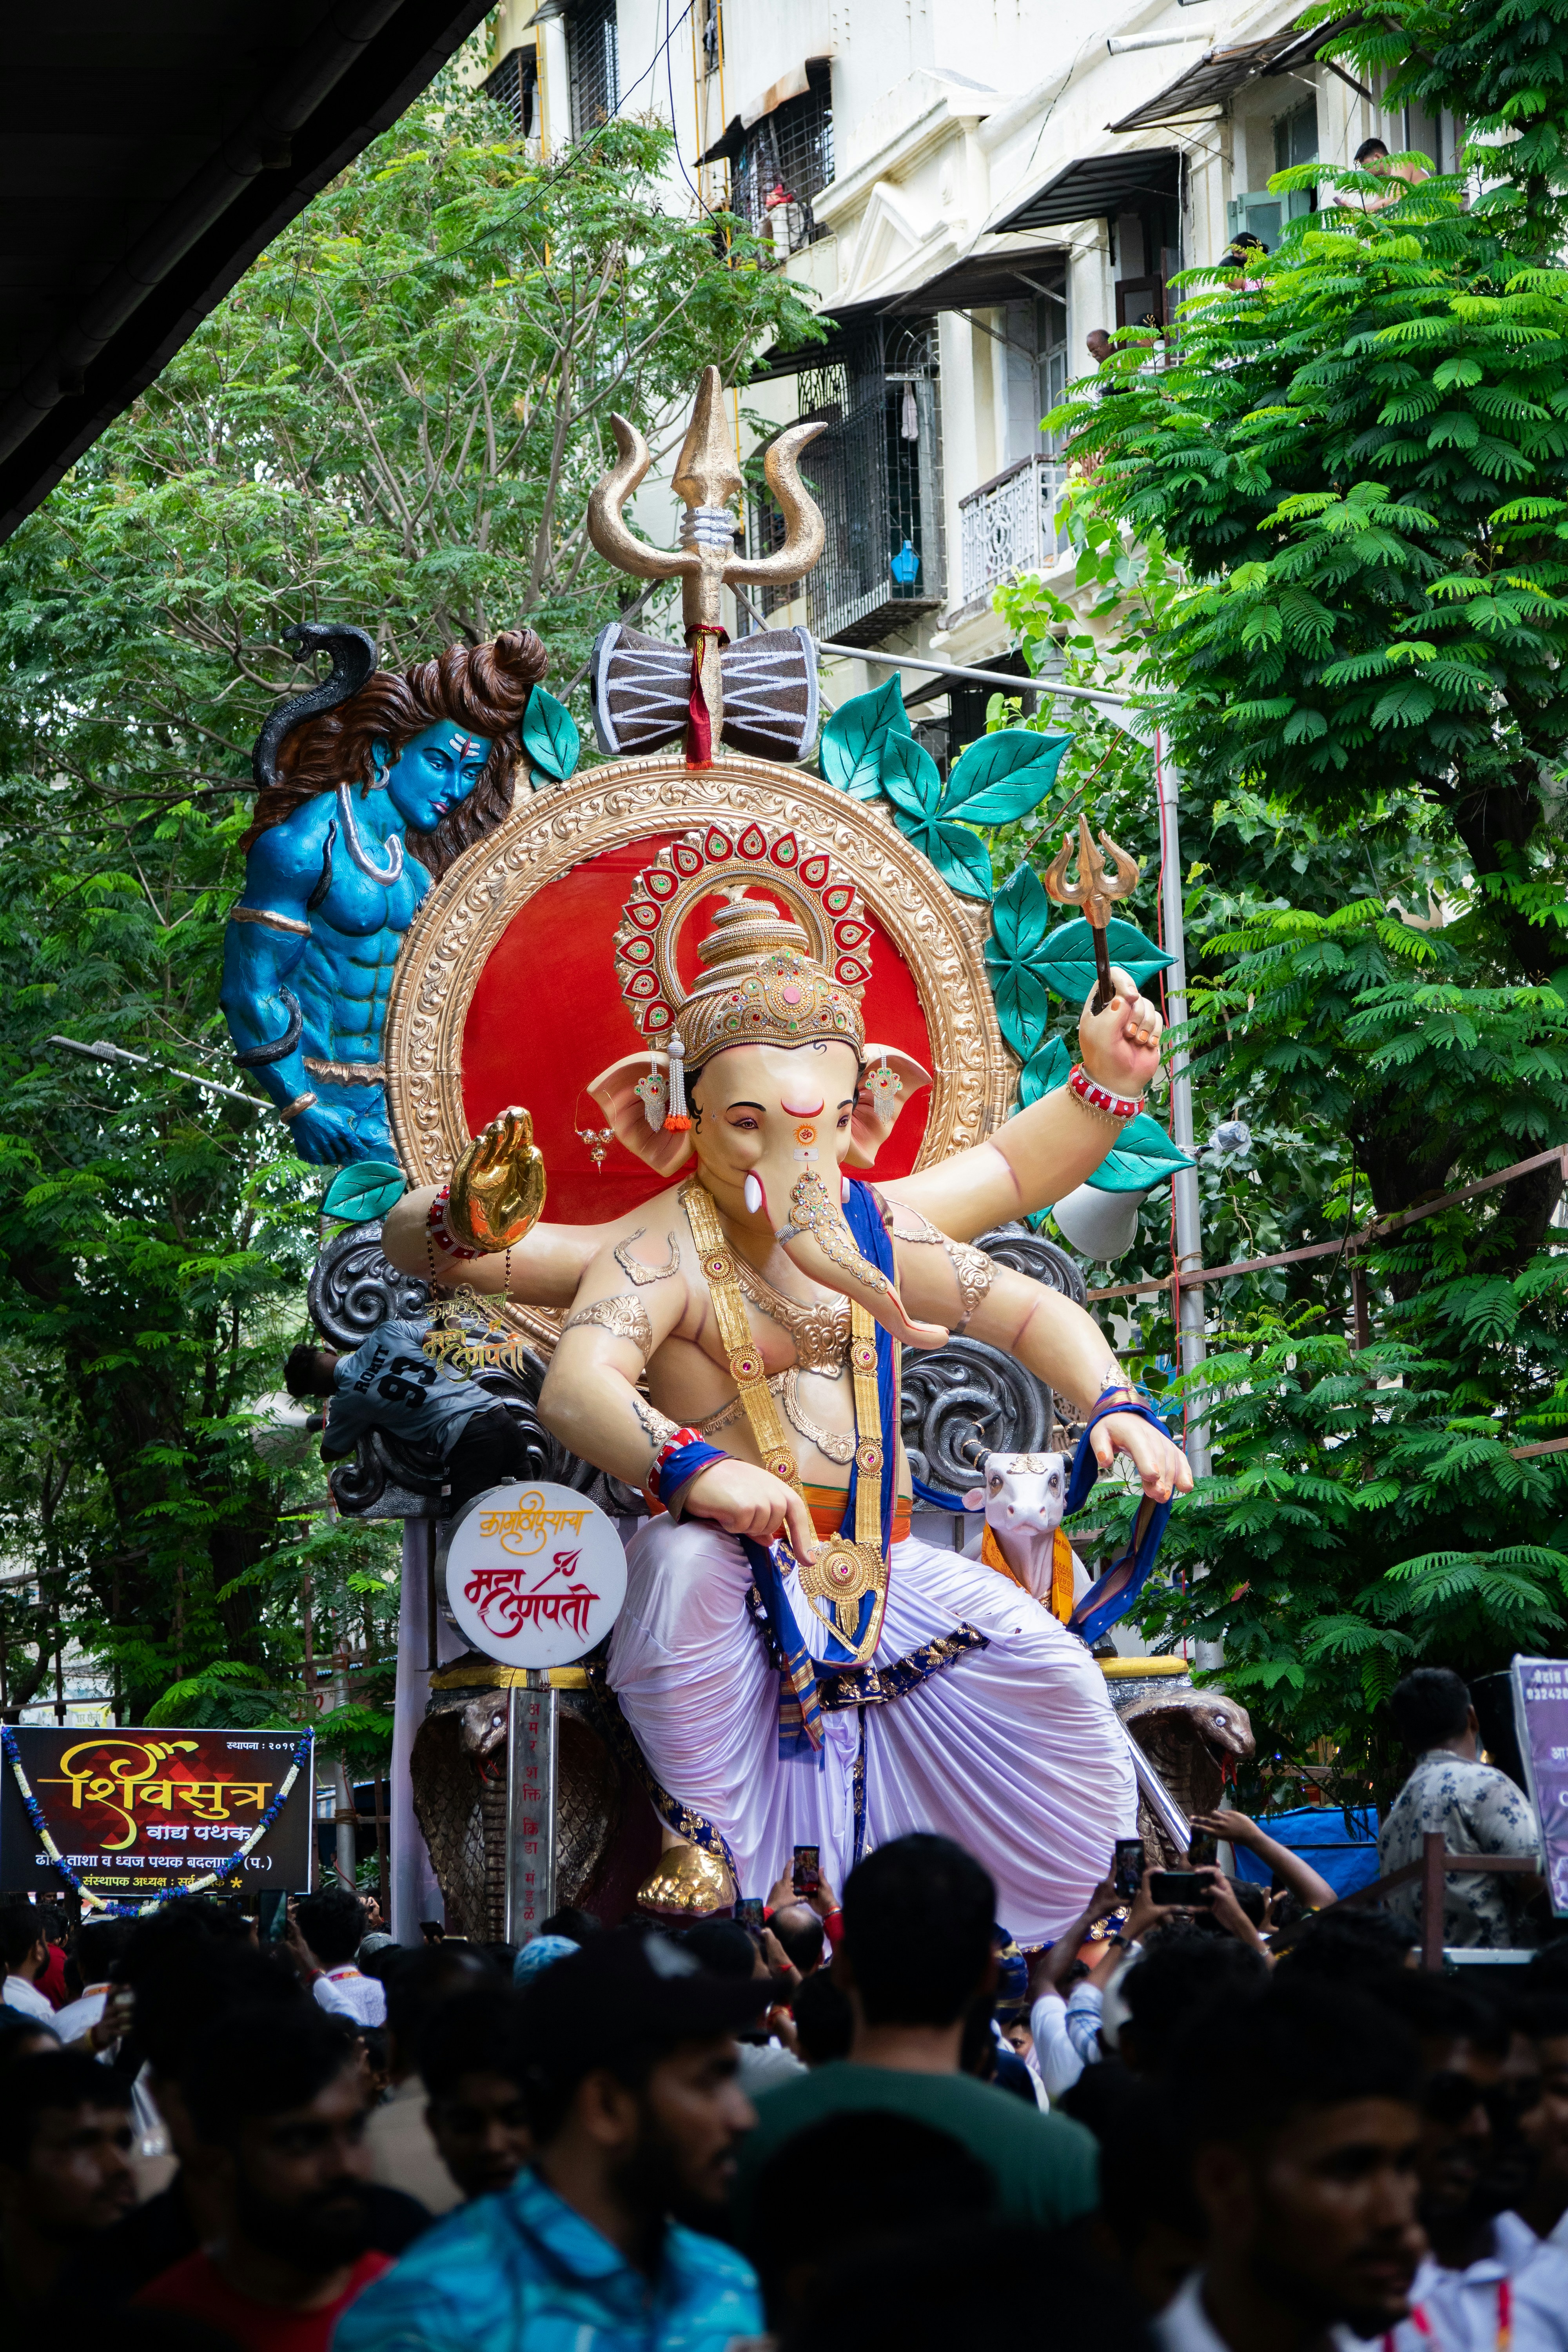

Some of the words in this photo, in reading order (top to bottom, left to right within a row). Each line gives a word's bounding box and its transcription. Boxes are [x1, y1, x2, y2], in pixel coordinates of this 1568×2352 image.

[423, 1328, 470, 1360] महा
[377, 1356, 438, 1408] 93
[465, 1570, 526, 1603] महा
[477, 1584, 601, 1643] गणपती
[528, 1703, 541, 1753] अमर
[227, 1742, 259, 1750] स्थापना
[269, 1743, 295, 1751] २०१९
[37, 1740, 272, 1850] शिवसुत्र
[146, 1826, 189, 1840] वाद्य
[194, 1826, 252, 1840] पथक
[66, 1855, 98, 1866] ताशा
[101, 1856, 112, 1867] व
[116, 1856, 145, 1867] ध्वज
[148, 1857, 183, 1867] पथक
[244, 1856, 272, 1871] (प.)
[82, 1873, 130, 1886] संस्थापक
[132, 1877, 167, 1887] अध्यक्ष
[524, 1869, 536, 1920] मंडळ
